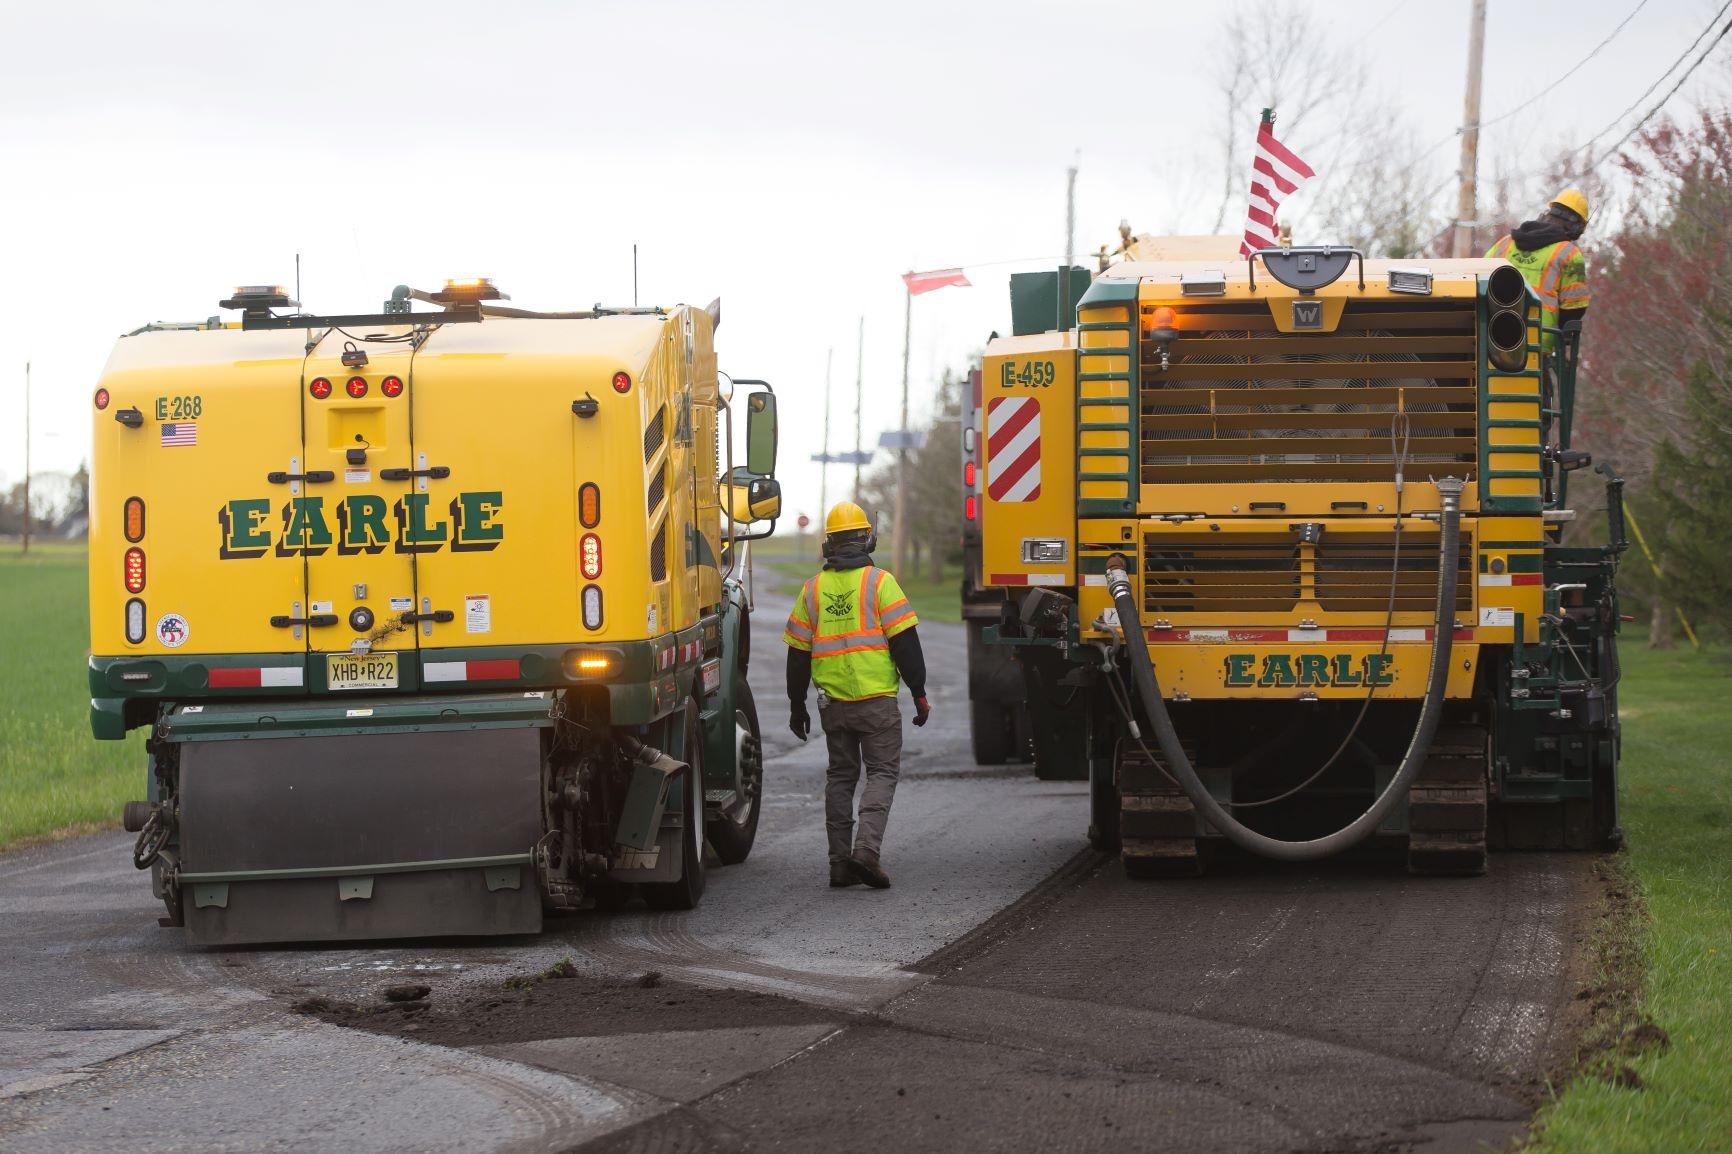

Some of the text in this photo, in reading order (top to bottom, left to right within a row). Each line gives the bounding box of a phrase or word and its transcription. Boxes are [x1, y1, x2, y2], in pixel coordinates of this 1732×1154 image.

[1296, 308, 1318, 323] W
[1001, 361, 1055, 388] E-459
[218, 491, 504, 560] EARLE
[825, 603, 854, 616] EARLE
[332, 662, 394, 681] XHB R22
[1223, 653, 1394, 688] EARLE
